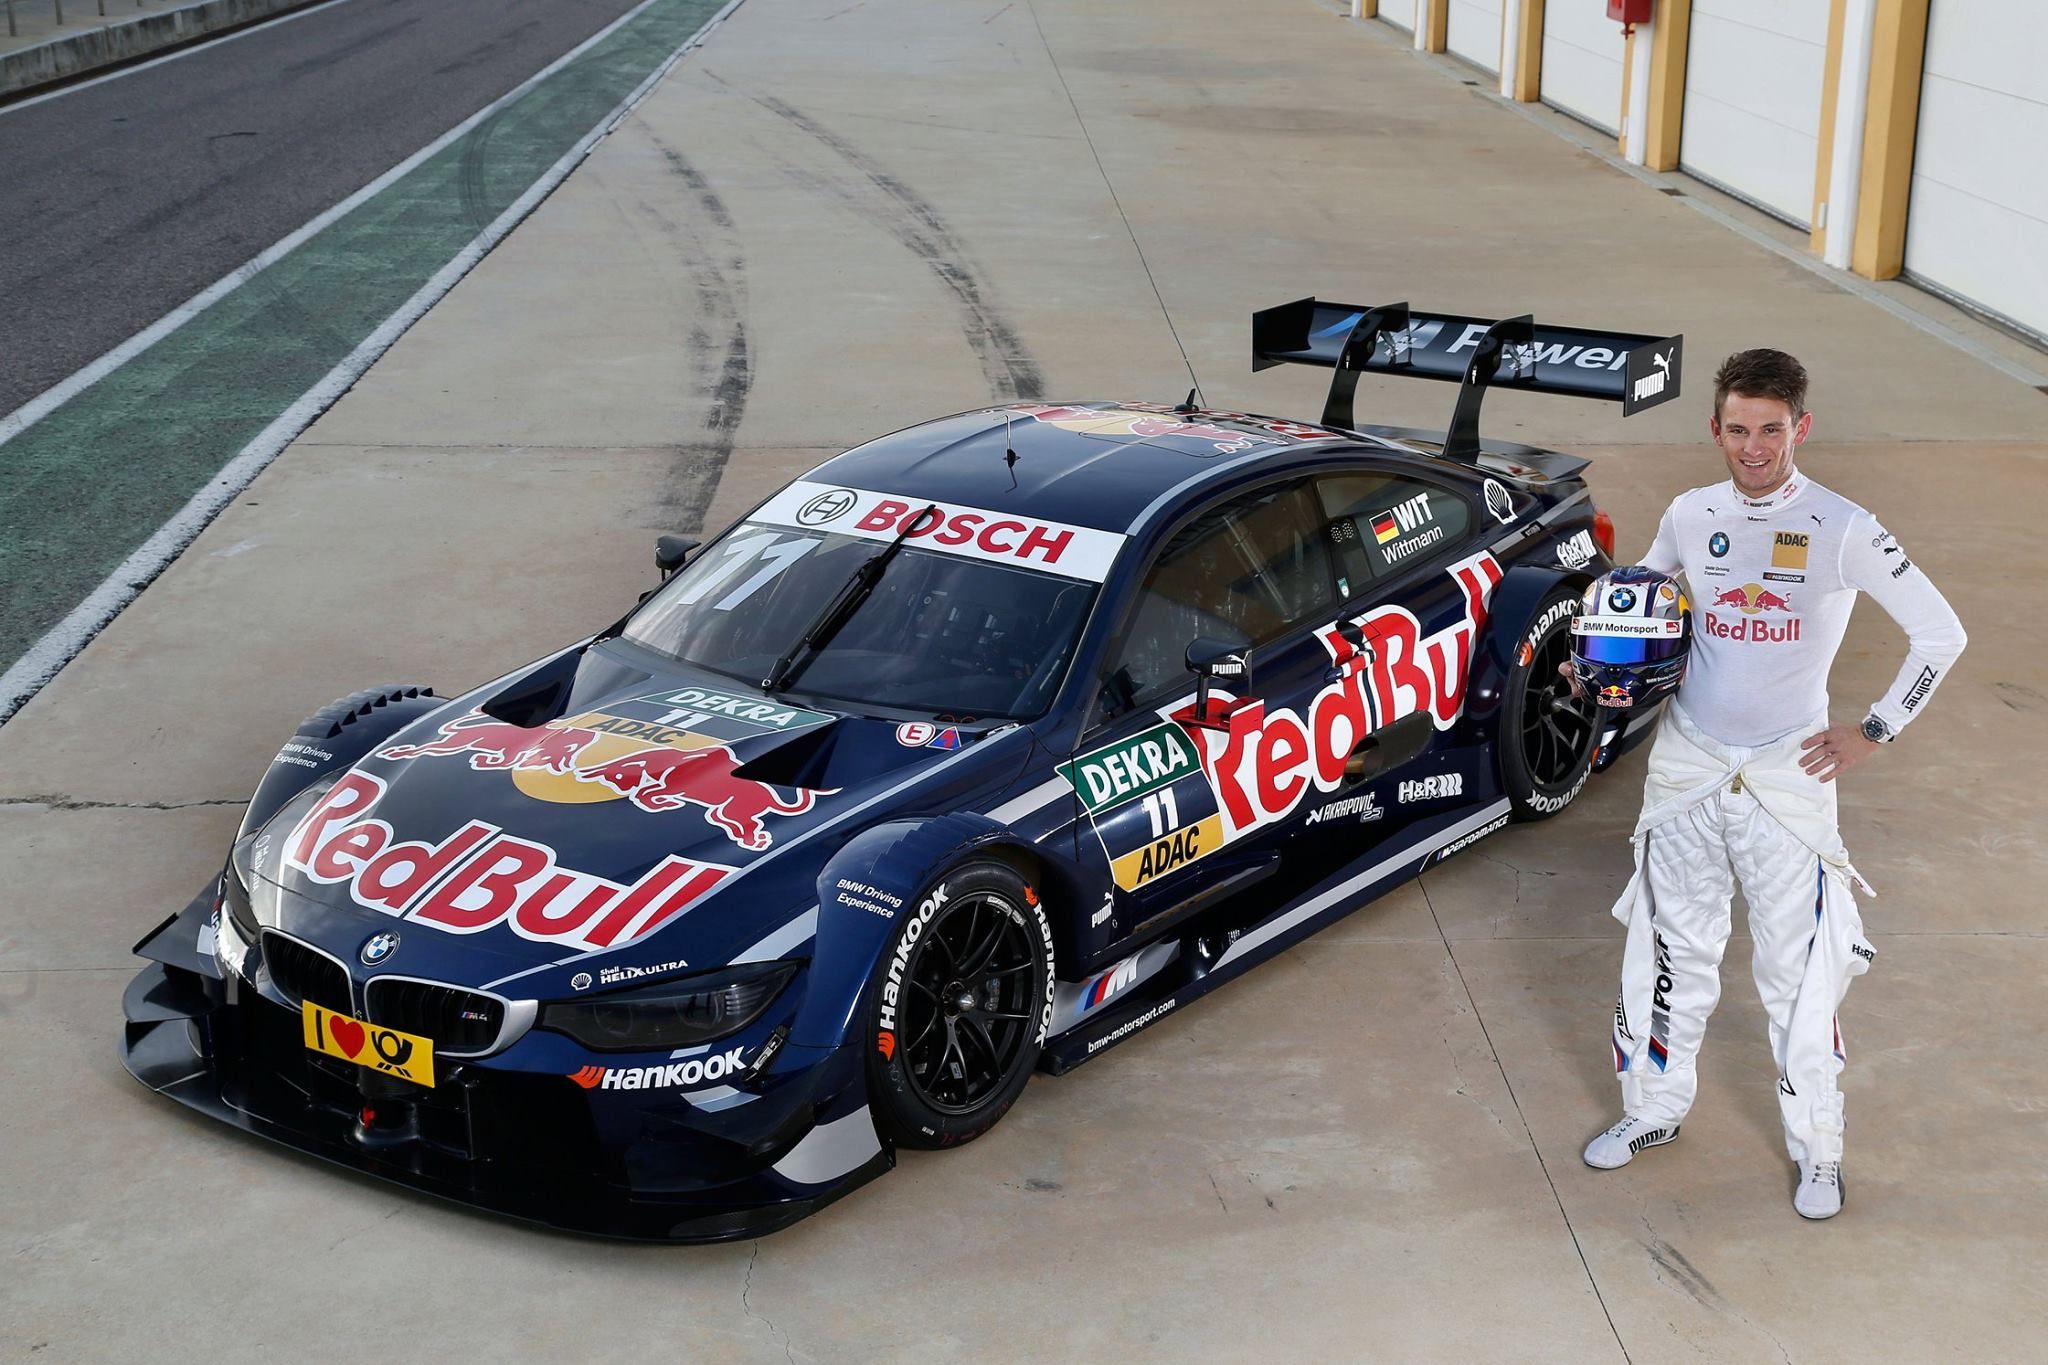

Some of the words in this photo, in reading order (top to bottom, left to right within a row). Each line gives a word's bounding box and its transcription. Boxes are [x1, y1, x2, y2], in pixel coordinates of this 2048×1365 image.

[1634, 371, 1665, 401] PUMA
[1392, 492, 1436, 532] WIT
[854, 500, 1075, 564] BOSCH
[1381, 525, 1444, 565] Wittmann
[1775, 533, 1809, 547] ADAC
[677, 532, 824, 611] 11
[1583, 622, 1603, 632] BMW
[1605, 623, 1658, 634] Motorsport
[1705, 612, 1747, 641] Red
[1752, 619, 1801, 642] Bull
[1212, 664, 1242, 674] PUMA
[1902, 665, 1938, 713] Zollner
[653, 708, 713, 729] 11
[665, 689, 799, 726] DEKRA
[587, 718, 686, 744] ADAC
[275, 754, 318, 769] Experience
[303, 746, 333, 761] Driving
[1081, 732, 1189, 804] DEKRA
[1141, 786, 1180, 838] 11
[1136, 825, 1200, 885] ADAC
[836, 879, 861, 897] BMW
[862, 886, 903, 908] Driving
[837, 892, 894, 919] Experience
[1091, 902, 1112, 929] PUMA
[600, 966, 619, 976] Shell
[601, 968, 646, 984] HELIX
[646, 960, 688, 975] ULTRA
[316, 1009, 325, 1049] I
[1087, 998, 1176, 1054] bmw-motorsport.com
